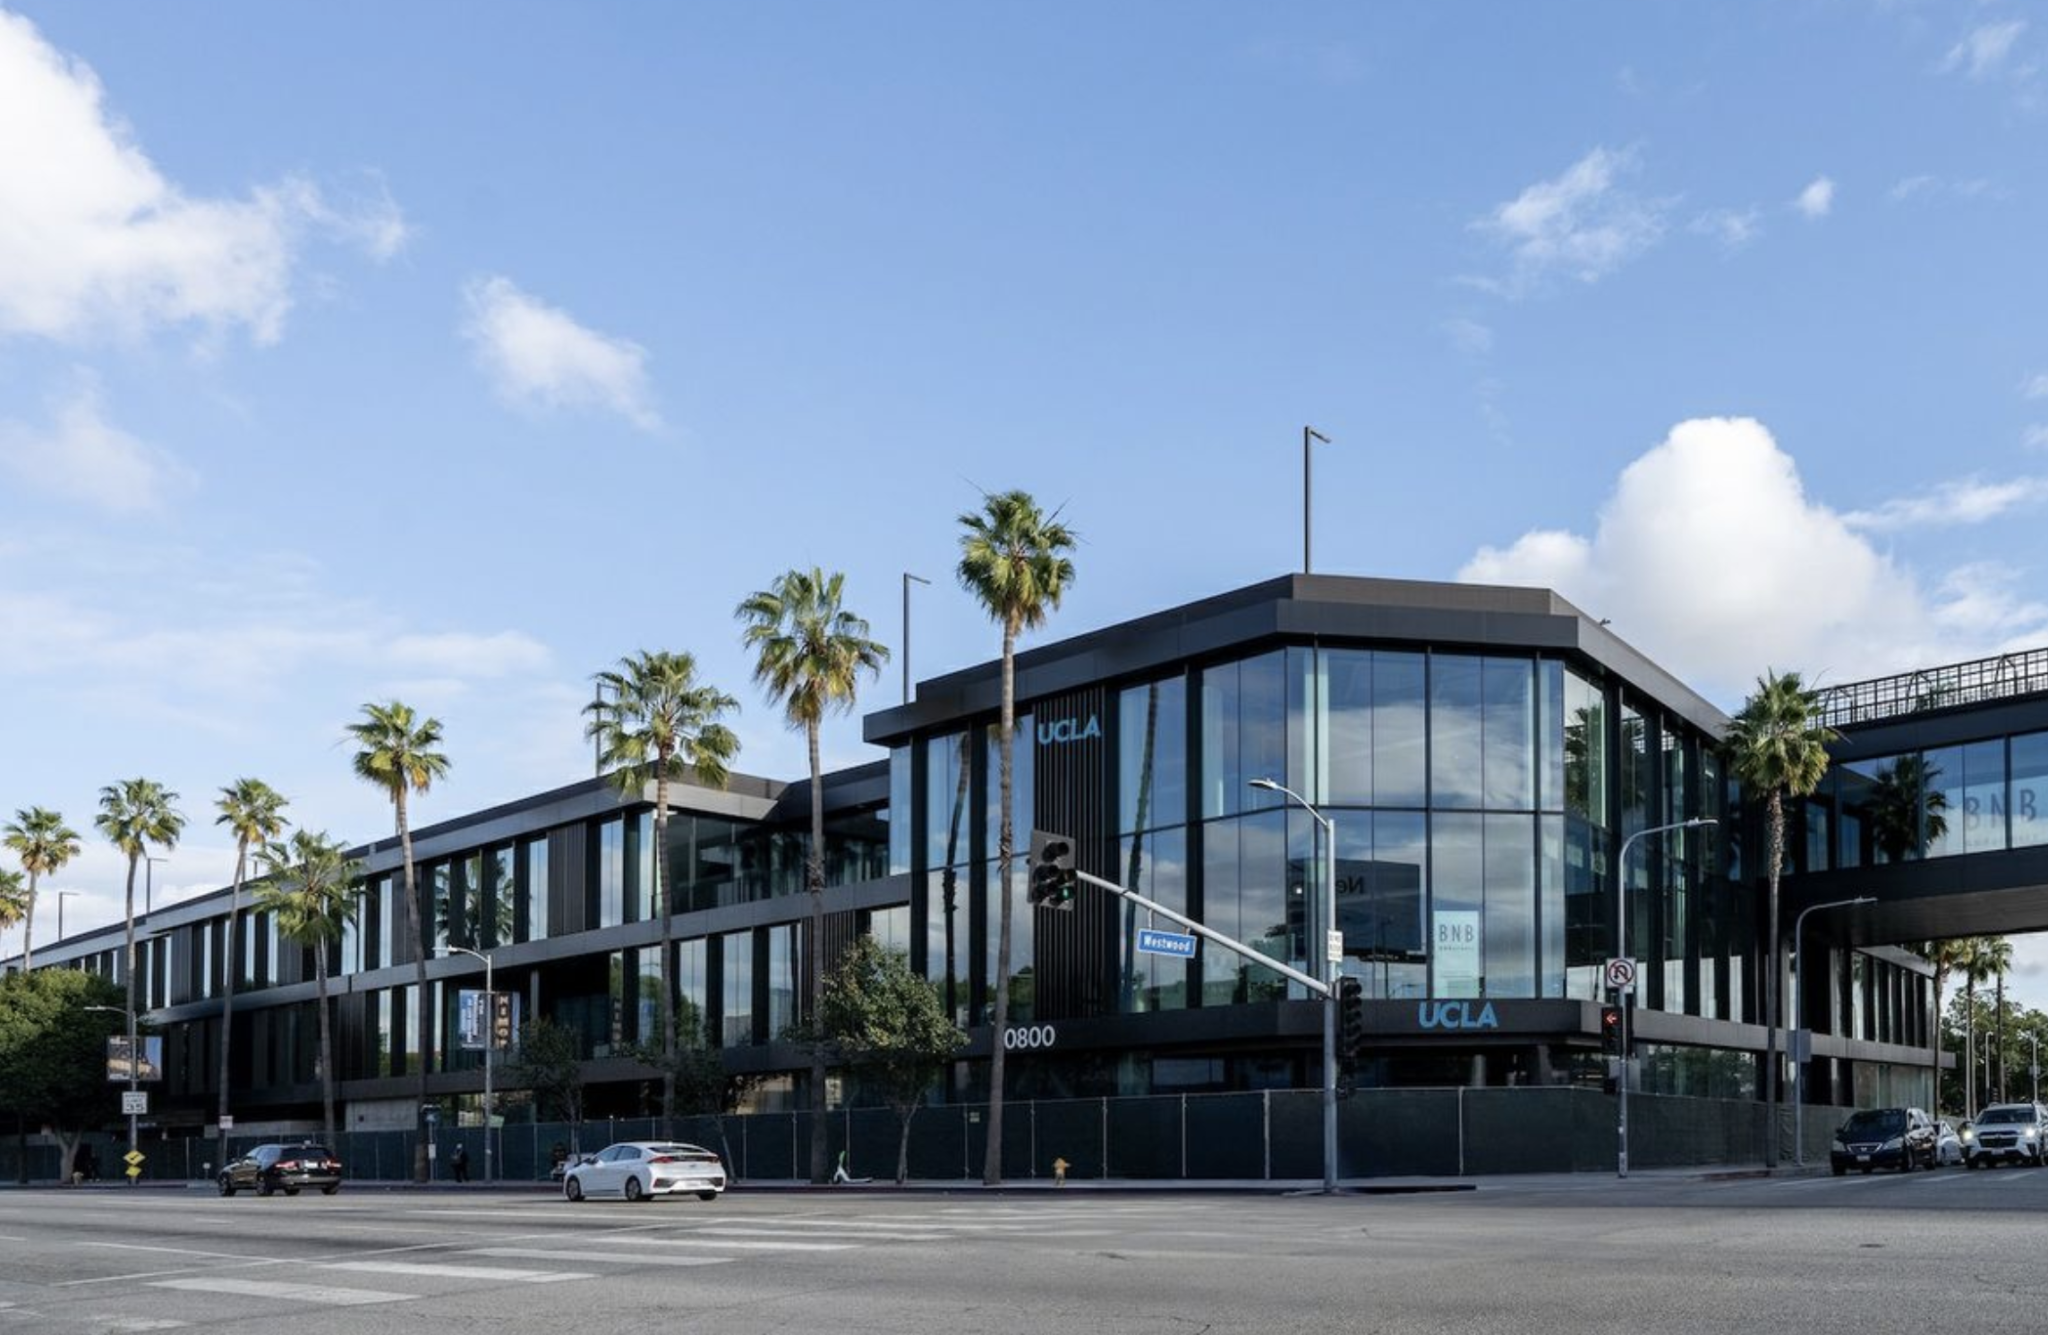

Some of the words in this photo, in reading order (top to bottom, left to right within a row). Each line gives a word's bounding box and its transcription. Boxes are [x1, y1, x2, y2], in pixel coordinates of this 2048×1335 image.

[1038, 715, 1101, 745] UCLA
[1143, 935, 1190, 952] Westwood
[1439, 924, 1475, 943] BNB
[1419, 1001, 1498, 1029] UCLA
